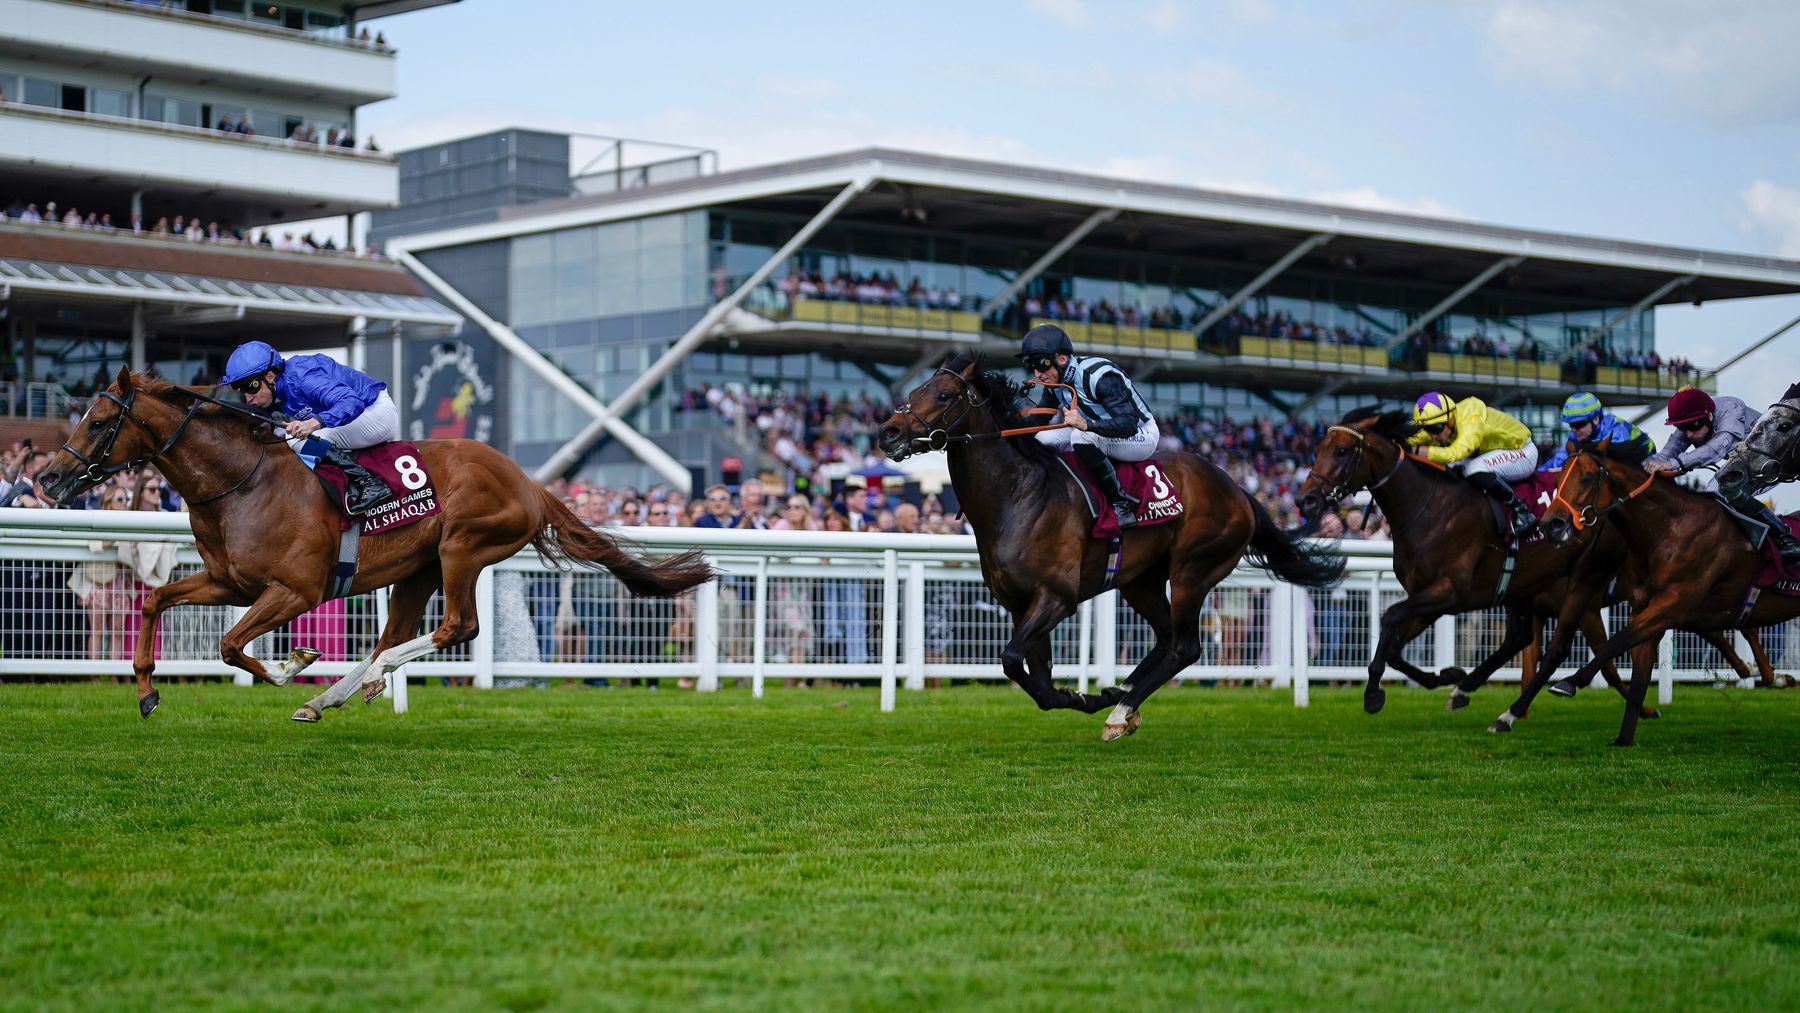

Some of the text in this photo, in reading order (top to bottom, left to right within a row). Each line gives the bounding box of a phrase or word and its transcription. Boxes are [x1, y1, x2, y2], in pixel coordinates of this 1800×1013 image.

[395, 455, 427, 490] 8
[1484, 450, 1526, 465] BAHRAIN
[1145, 465, 1169, 499] 3
[364, 499, 435, 532] AL SHAQAB
[365, 488, 433, 516] MODERN GAMES
[1148, 495, 1177, 510] CHINDIT
